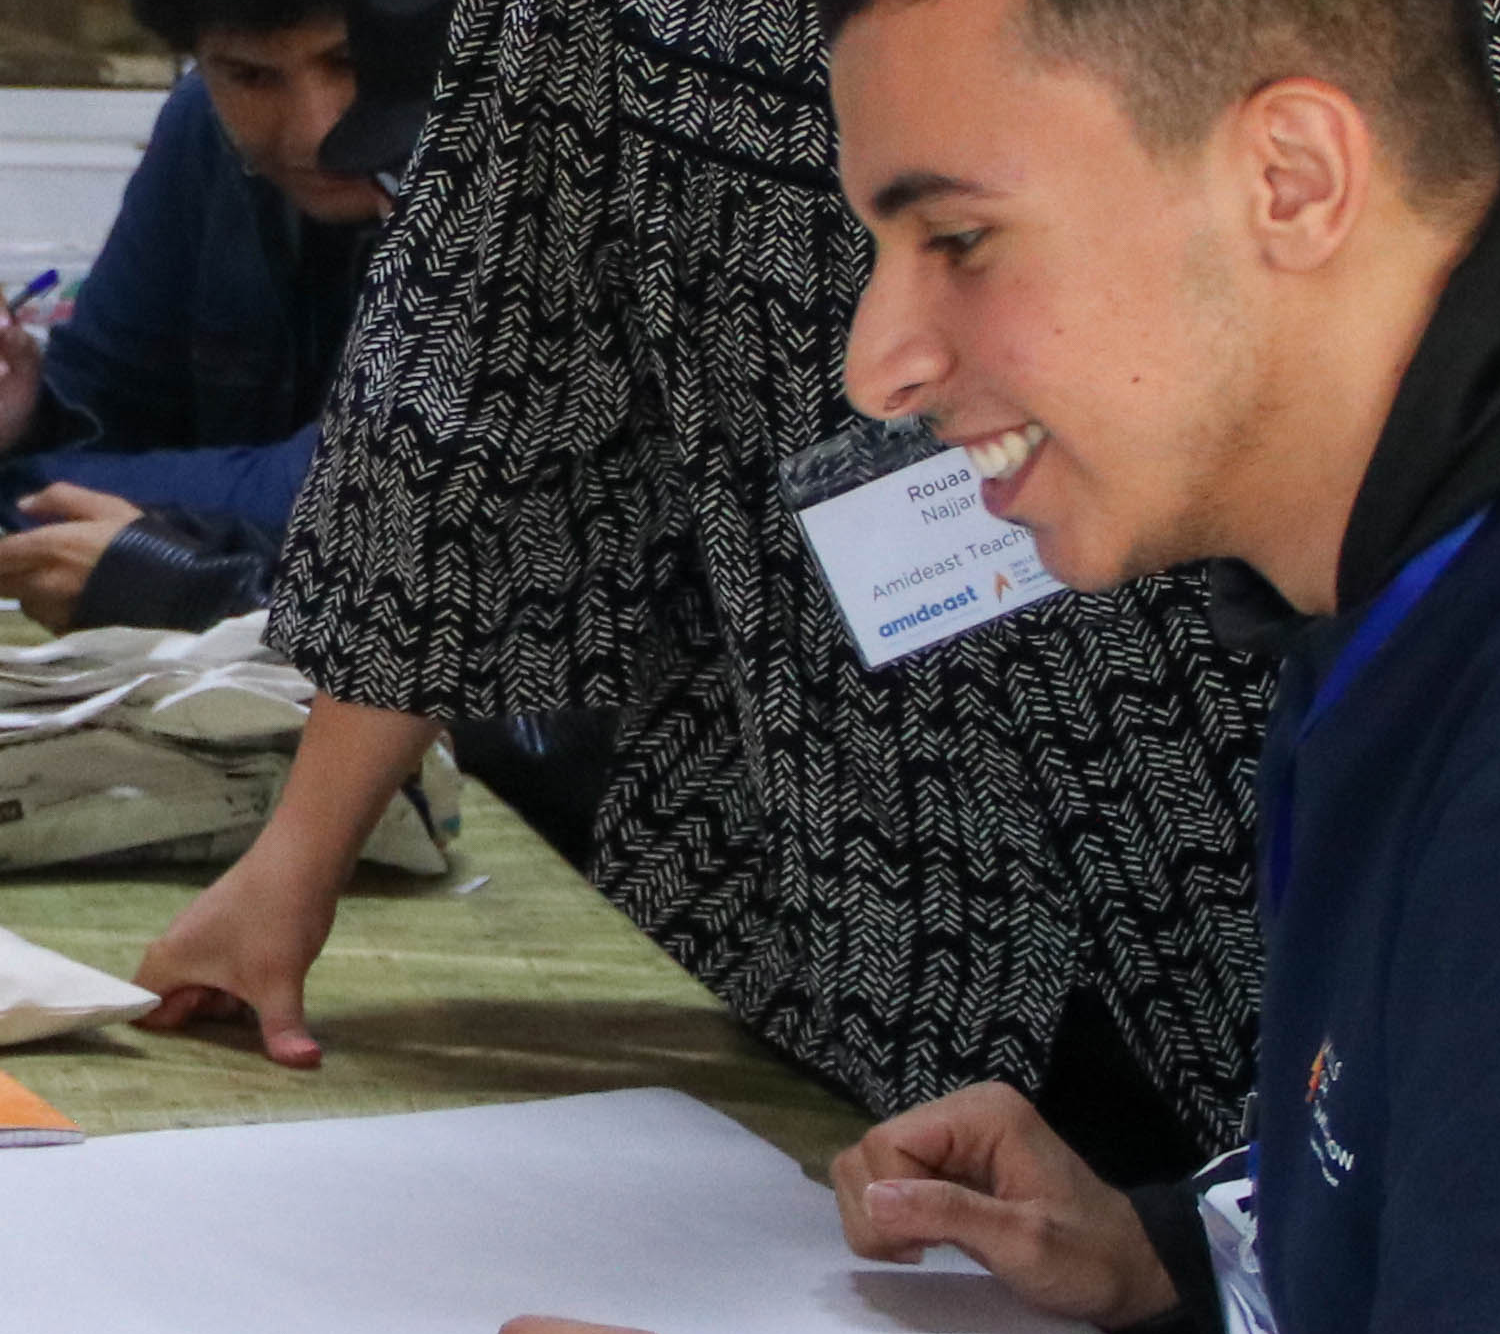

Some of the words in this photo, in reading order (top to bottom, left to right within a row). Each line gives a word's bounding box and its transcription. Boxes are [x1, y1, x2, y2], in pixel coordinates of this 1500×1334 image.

[907, 466, 972, 505] Rouaa
[920, 491, 978, 527] Najjar
[871, 552, 964, 602] Amideast
[877, 584, 979, 640] amideast
